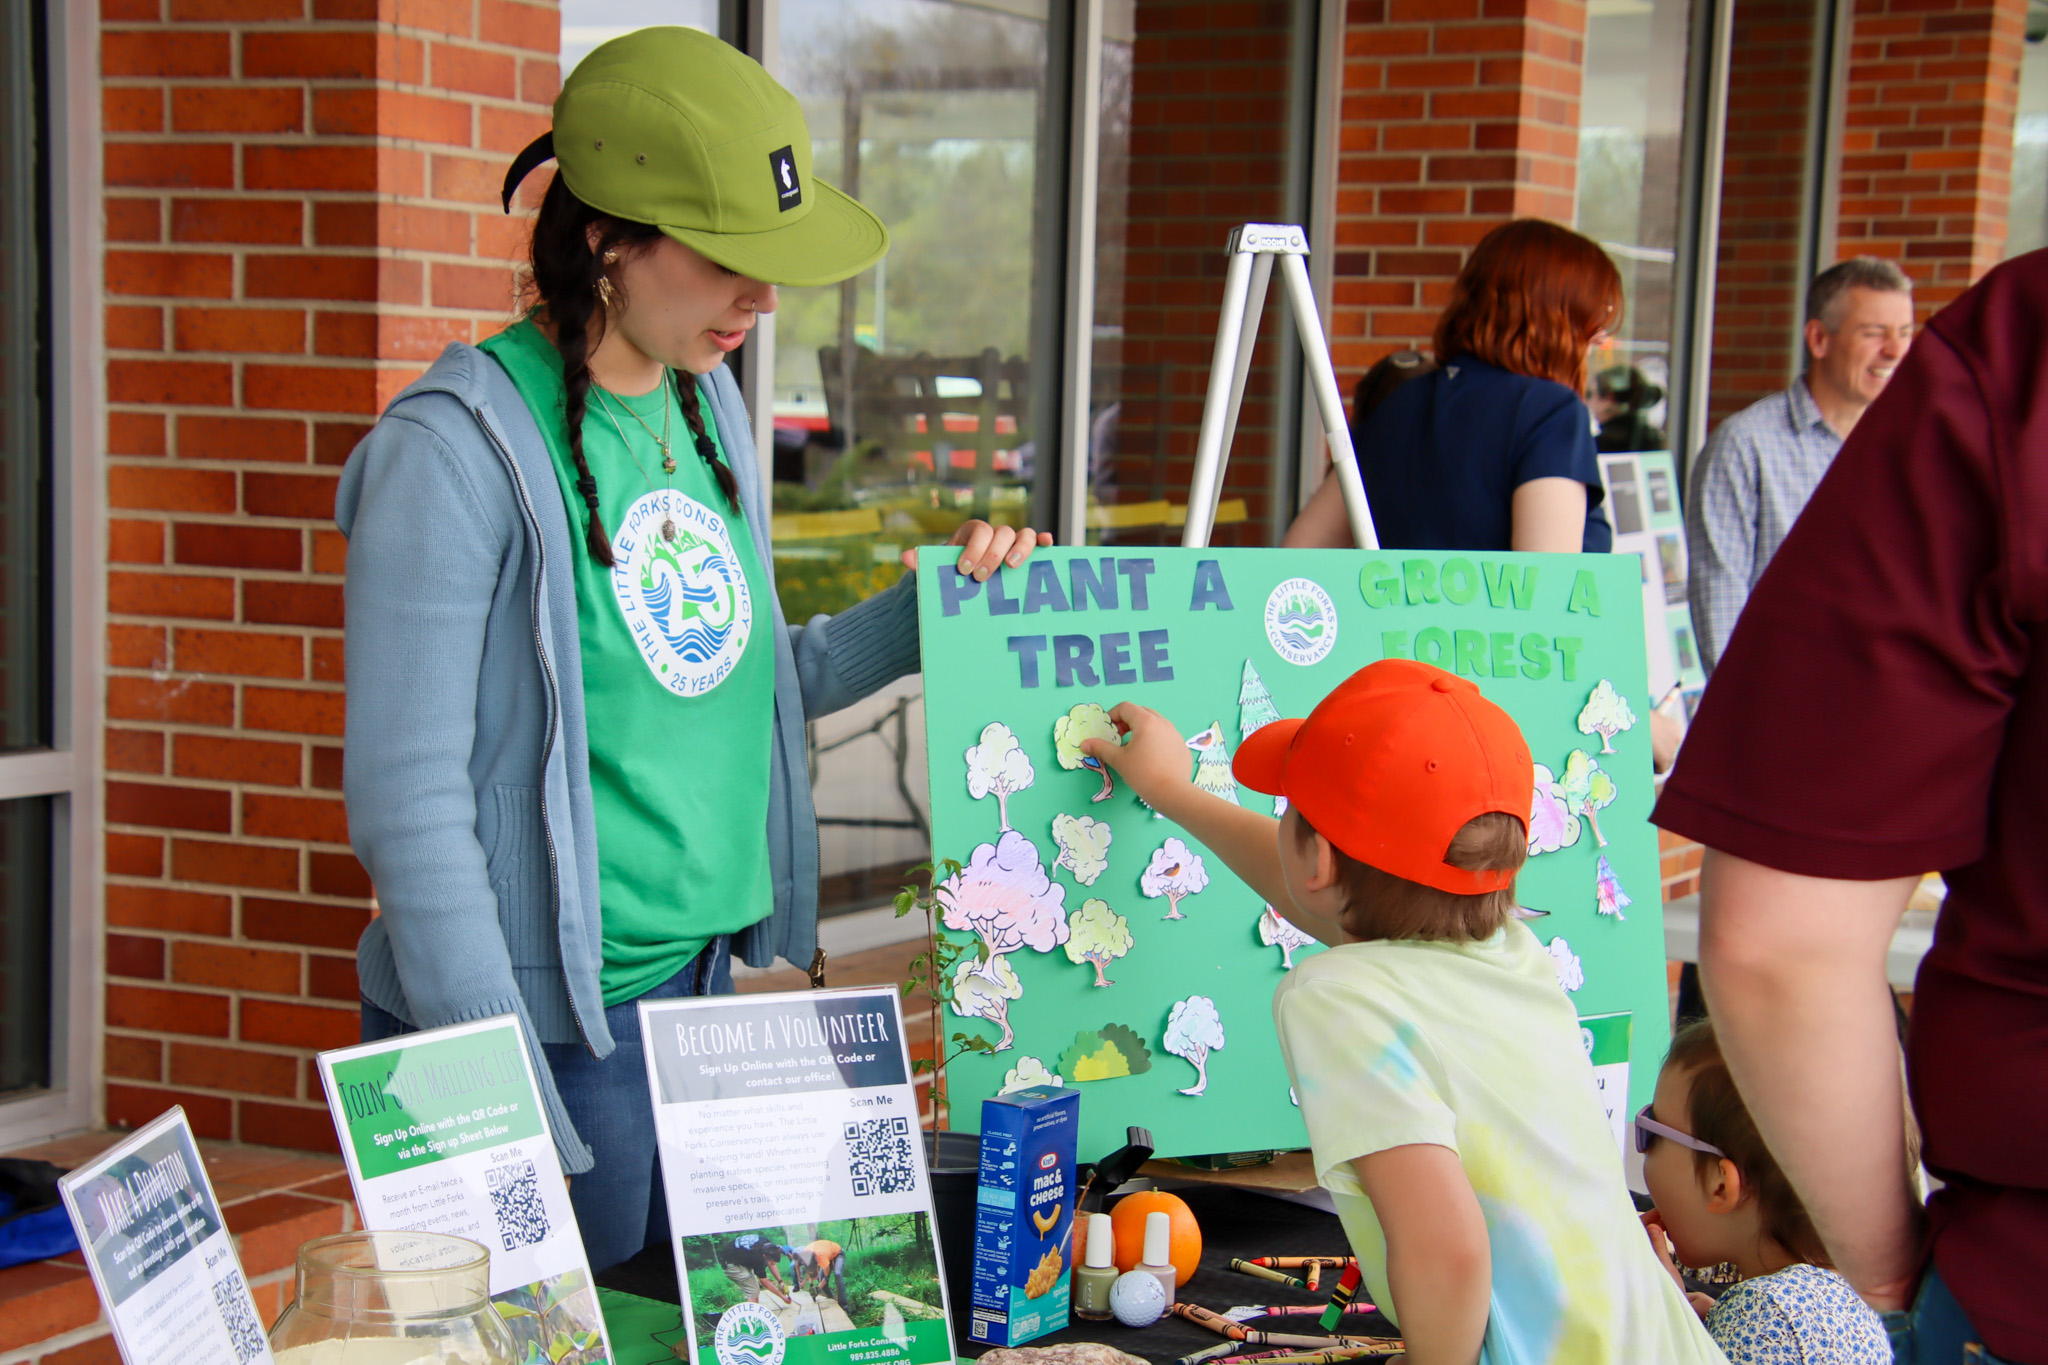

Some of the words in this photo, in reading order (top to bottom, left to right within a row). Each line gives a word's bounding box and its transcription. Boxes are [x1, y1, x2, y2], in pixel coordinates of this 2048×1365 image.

[629, 496, 670, 534] FORKS
[615, 537, 635, 612] LITTLE
[938, 557, 1155, 618] PLANT
[1188, 560, 1236, 612] A
[1359, 558, 1539, 610] GROW
[1568, 569, 1601, 618] A
[1266, 600, 1277, 623] THE
[1275, 580, 1308, 598] LITTLE
[1311, 585, 1336, 623] FORKS
[633, 619, 659, 663] THE
[1270, 631, 1334, 663] CONSERVANCY
[1382, 626, 1584, 682] FOREST
[1006, 628, 1174, 688] TREE
[670, 672, 687, 692] 25
[691, 656, 732, 693] YEARS
[699, 1064, 721, 1077] Sign
[724, 1062, 738, 1074] Up
[741, 1060, 774, 1072] Online
[776, 1058, 798, 1069] with
[800, 1057, 816, 1067] the
[818, 1055, 835, 1066] QR
[836, 1053, 863, 1064] Code
[865, 1053, 876, 1062] or
[746, 1076, 783, 1088] contact
[785, 1075, 802, 1084] our
[804, 1071, 836, 1083] office!
[698, 1110, 712, 1119] No
[713, 1107, 742, 1118] matter
[744, 1105, 764, 1116] what
[766, 1103, 786, 1113] skills
[787, 1102, 804, 1112] and
[850, 1096, 874, 1108] Scan
[876, 1095, 892, 1106] Me
[374, 1132, 394, 1146] Sign
[394, 1128, 408, 1142] Up
[408, 1122, 436, 1137] Online
[437, 1117, 456, 1131] with
[456, 1114, 470, 1126] the
[472, 1108, 486, 1120] QR
[486, 1104, 509, 1118] Code
[510, 1102, 519, 1112] or
[688, 1124, 734, 1136] experience
[736, 1122, 752, 1133] you
[778, 1118, 795, 1126] The
[797, 1116, 818, 1125] Little
[398, 1149, 411, 1160] via
[412, 1144, 426, 1158] the
[427, 1140, 446, 1154] Sign
[447, 1138, 459, 1150] up
[460, 1130, 483, 1145] Sheet
[484, 1124, 509, 1138] Below
[684, 1140, 708, 1150] Forks
[709, 1136, 763, 1149] Conservancy
[764, 1134, 780, 1143] can
[782, 1132, 810, 1144] always
[811, 1130, 826, 1138] use
[490, 1150, 509, 1164] Scan
[510, 1147, 523, 1158] Me
[706, 1152, 738, 1166] helping
[766, 1146, 802, 1158] Whether
[803, 1145, 816, 1154] it's
[690, 1168, 724, 1182] planting
[726, 1166, 752, 1177] native
[754, 1163, 788, 1176] species,
[790, 1159, 830, 1172] removing
[382, 1188, 408, 1204] Receive
[409, 1188, 418, 1198] an
[418, 1180, 440, 1195] E-mail
[441, 1176, 459, 1190] twice
[459, 1176, 464, 1184] a
[693, 1183, 726, 1195] invasive
[728, 1179, 762, 1193] species,
[764, 1180, 773, 1188] or
[775, 1174, 824, 1188] maintaining
[390, 1204, 412, 1220] month
[412, 1200, 429, 1214] from
[430, 1194, 446, 1210] Little
[446, 1192, 464, 1206] Forks
[706, 1194, 748, 1210] preserve's
[775, 1192, 794, 1204] your
[795, 1189, 814, 1202] help
[816, 1189, 823, 1198] is
[428, 1212, 450, 1226] events,
[451, 1208, 470, 1221] news,
[468, 1219, 480, 1232] and
[724, 1210, 754, 1224] greatly
[114, 1250, 128, 1265] Scan
[126, 1243, 135, 1255] the
[134, 1235, 144, 1249] QR
[142, 1227, 156, 1244] Code
[155, 1224, 162, 1234] to
[162, 1213, 178, 1230] donate
[178, 1204, 192, 1219] online
[191, 1200, 197, 1209] or
[128, 1266, 138, 1280] out
[136, 1263, 144, 1274] an
[143, 1248, 165, 1269] envelope
[164, 1239, 176, 1253] with
[174, 1232, 185, 1249] your
[185, 1218, 206, 1238] donation
[205, 1255, 219, 1269] Scan
[218, 1248, 227, 1258] Me
[716, 1325, 726, 1346] THE
[724, 1303, 754, 1322] LITTLE
[758, 1305, 784, 1339] FORKS
[828, 1341, 847, 1352] Little
[848, 1338, 869, 1350] Forks
[870, 1334, 917, 1348] Conservancy
[850, 1348, 900, 1362] 989.835.4886
